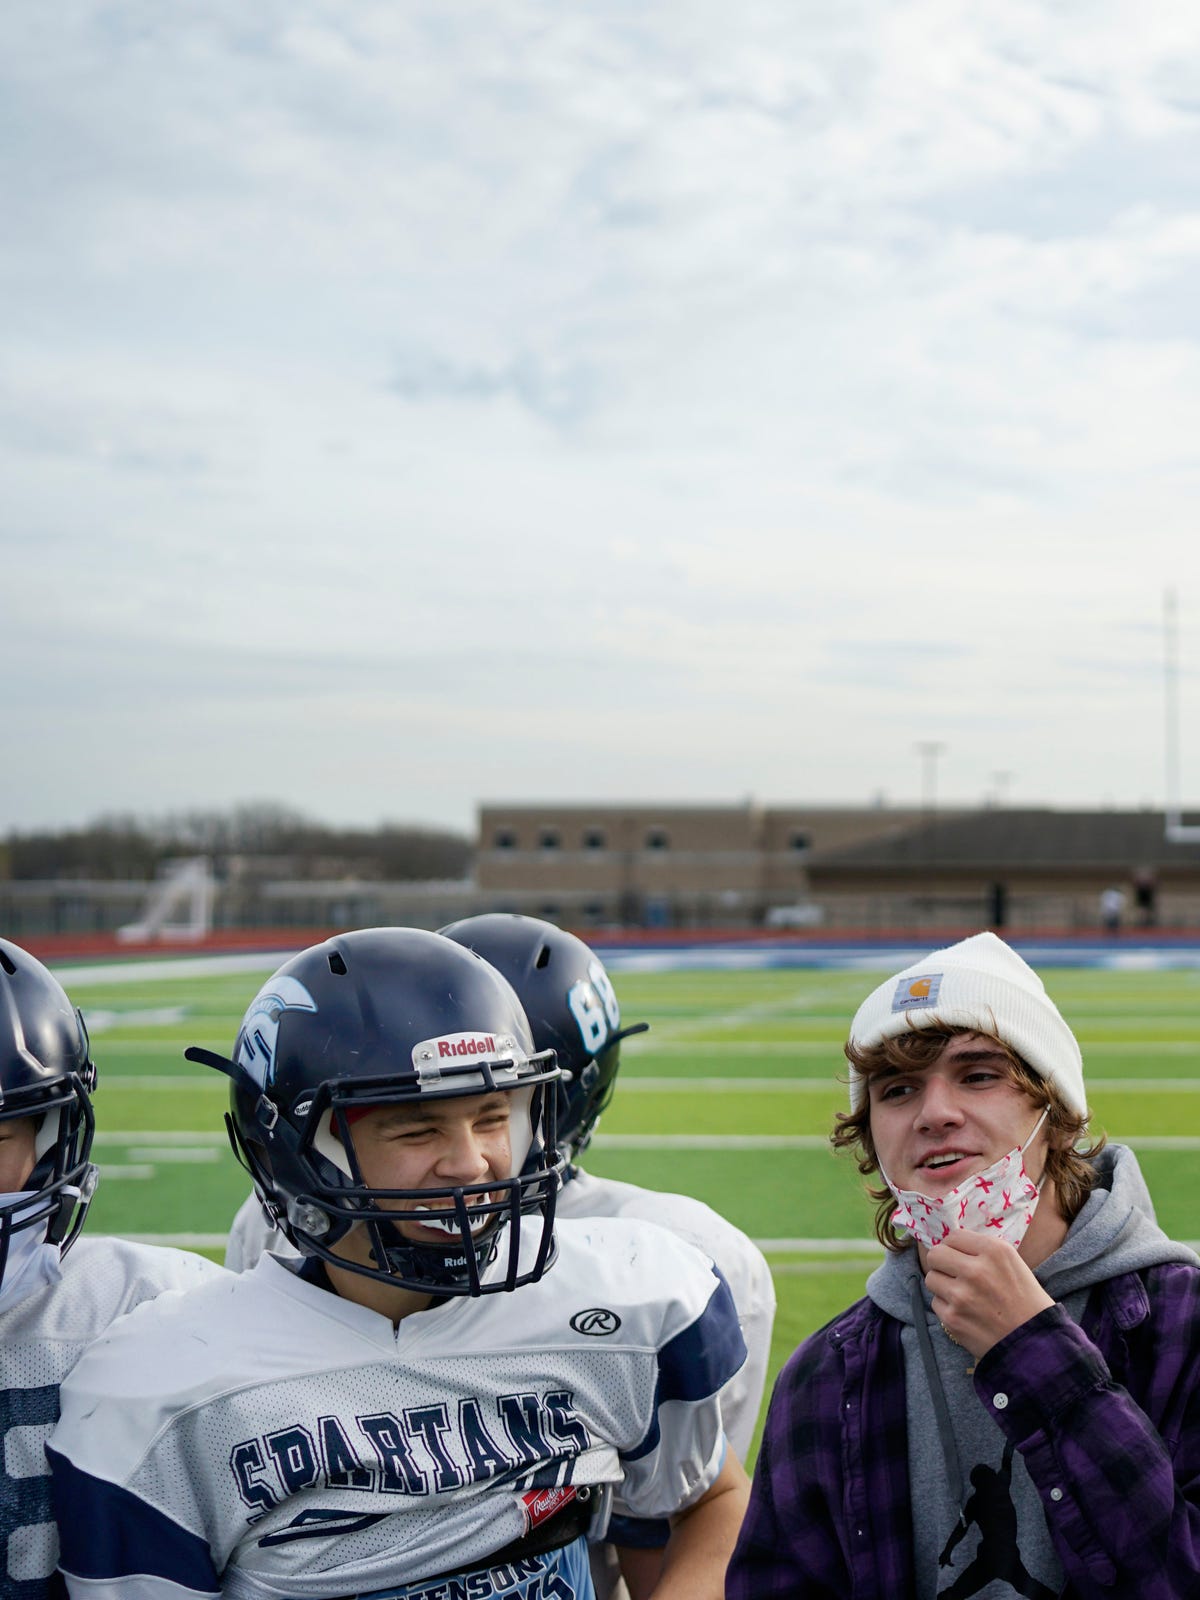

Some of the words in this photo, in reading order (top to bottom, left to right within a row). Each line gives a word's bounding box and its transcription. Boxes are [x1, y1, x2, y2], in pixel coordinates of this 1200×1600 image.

[437, 1036, 496, 1058] Riddell
[444, 1251, 481, 1267] Ridll
[229, 1390, 592, 1525] SPARTANS
